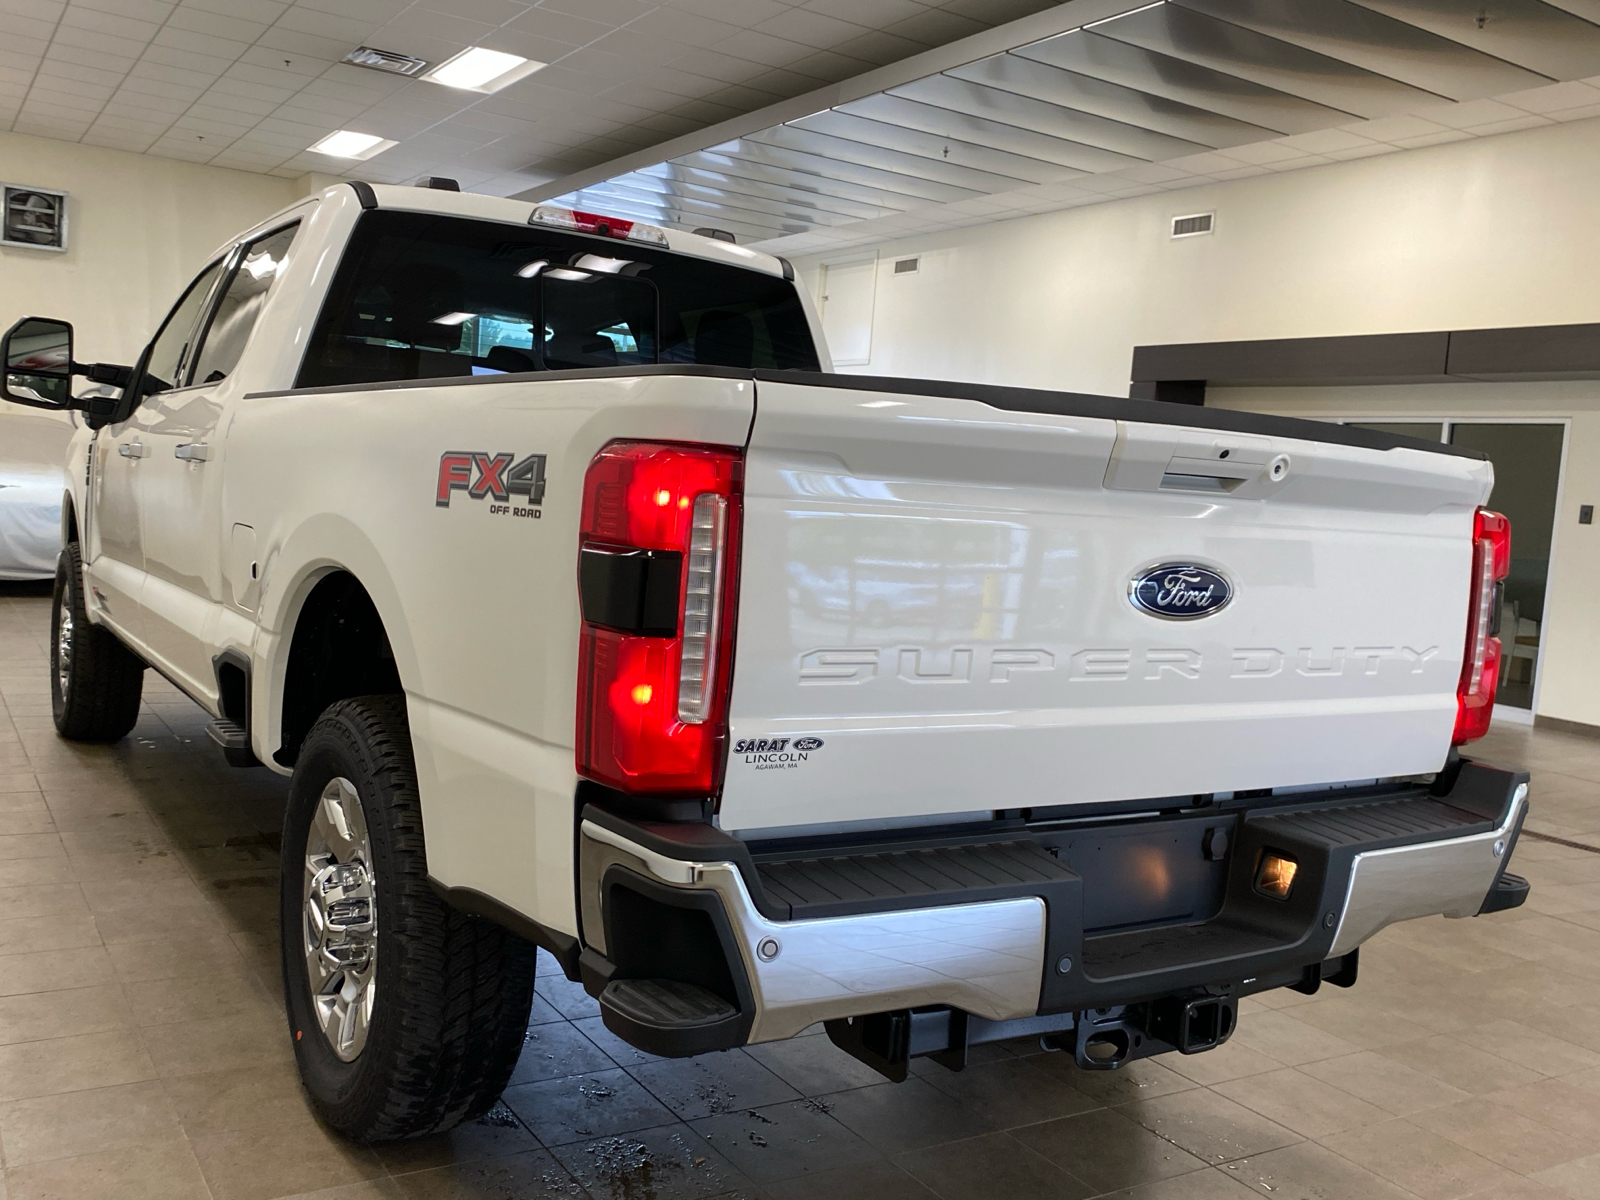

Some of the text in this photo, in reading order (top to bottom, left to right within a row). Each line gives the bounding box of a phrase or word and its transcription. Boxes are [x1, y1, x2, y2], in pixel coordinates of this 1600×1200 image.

[436, 450, 547, 508] FX4
[490, 504, 542, 519] OFF ROAD
[1156, 573, 1215, 607] Ford
[798, 645, 1439, 686] SUPER DUTY
[733, 738, 791, 754] SARAT
[745, 753, 808, 763] LINCOLN
